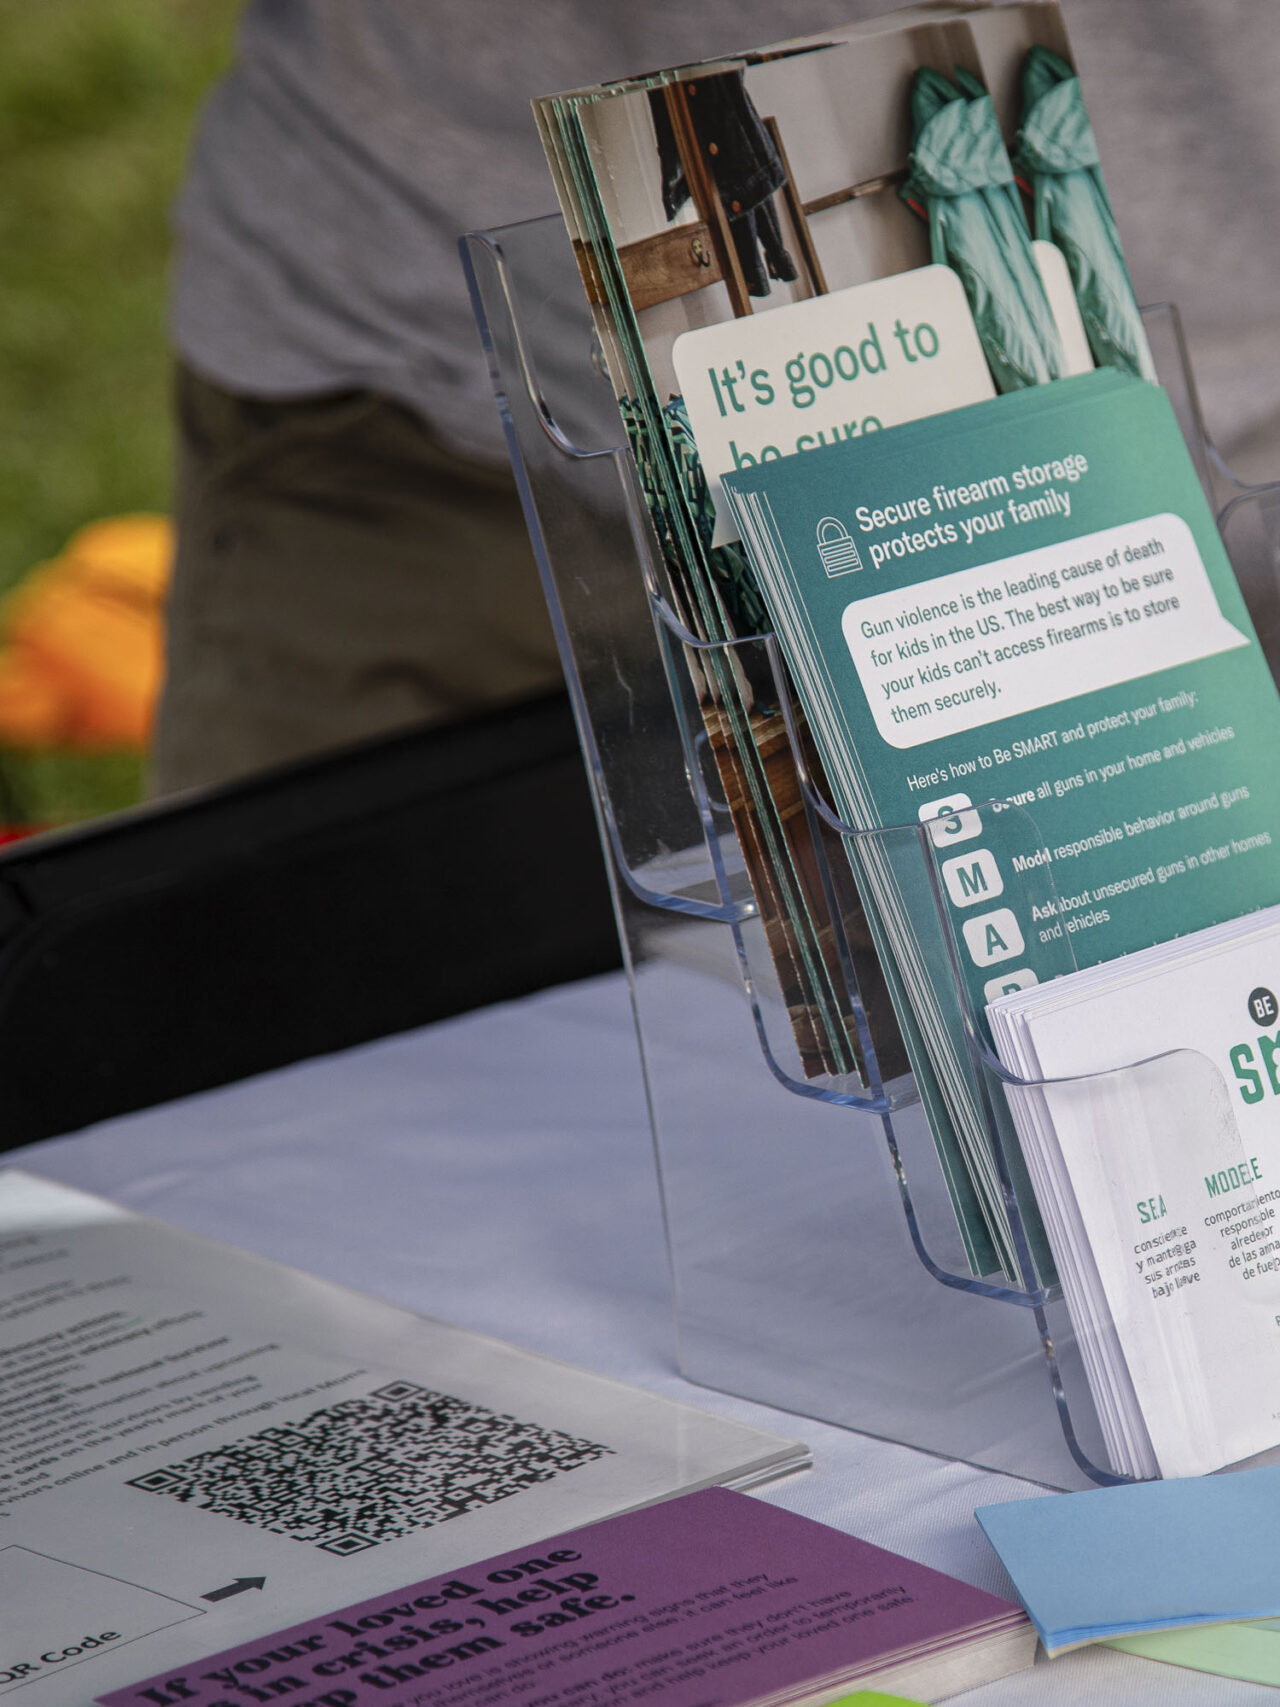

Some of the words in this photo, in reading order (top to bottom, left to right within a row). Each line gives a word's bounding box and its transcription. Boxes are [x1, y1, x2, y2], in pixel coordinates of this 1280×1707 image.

[707, 359, 775, 418] It’s
[784, 322, 888, 409] good
[893, 319, 940, 363] to
[855, 497, 932, 532] Secure
[932, 475, 1011, 511] firearm
[1011, 454, 1089, 490] storage
[868, 522, 959, 570] protects
[958, 509, 1006, 545] your
[1007, 487, 1072, 524] family
[860, 619, 895, 639] Gun
[895, 600, 960, 629] violence
[959, 593, 976, 611] is
[976, 586, 1003, 606] the
[1003, 569, 1061, 598] leading
[1060, 558, 1104, 582] cause
[1105, 548, 1121, 569] of
[1123, 538, 1166, 564] death
[870, 649, 893, 668] for
[895, 637, 930, 660] kids
[929, 632, 948, 650] in
[948, 625, 976, 645] the
[975, 614, 1006, 636] US.
[1003, 607, 1036, 627] The
[1035, 595, 1072, 619] best
[1071, 589, 1101, 608] way
[1101, 583, 1120, 599] to
[1119, 577, 1141, 594] be
[1141, 568, 1175, 588] sure
[880, 674, 915, 701] your
[916, 662, 952, 685] kids
[993, 636, 1046, 663] access
[1046, 617, 1109, 647] firearms
[1107, 610, 1124, 628] is
[1123, 607, 1142, 623] to
[1142, 596, 1181, 618] store
[890, 701, 933, 724] them
[934, 679, 1002, 711] securely.
[906, 767, 949, 792] Here's
[948, 760, 977, 779] how
[977, 755, 993, 769] to
[992, 748, 1012, 765] Be
[1011, 730, 1059, 759] SMART
[1060, 722, 1086, 744] and
[1086, 710, 1132, 739] protect
[1129, 703, 1158, 726] your
[1157, 690, 1199, 713] family:
[1036, 781, 1053, 799] all
[1053, 774, 1085, 798] guns
[1083, 768, 1099, 784] in
[1098, 756, 1133, 783] your
[1125, 749, 1162, 770] home
[1162, 739, 1187, 759] and
[1186, 726, 1236, 751] vehicles
[1053, 828, 1124, 860] responsible
[1123, 810, 1176, 837] behavior
[1177, 796, 1220, 820] around
[1220, 786, 1250, 809] guns
[956, 861, 989, 898] M
[1031, 900, 1059, 922] Ask
[1091, 869, 1156, 902] unsecured
[1155, 860, 1187, 884] guns
[1186, 855, 1200, 870] in
[1198, 844, 1231, 866] other
[1230, 831, 1272, 854] homes
[985, 923, 1009, 957] A
[1038, 920, 1064, 943] and
[1253, 995, 1275, 1019] BE
[13, 1456, 60, 1475] cards
[60, 1447, 85, 1458] on
[53, 1464, 106, 1486] online
[106, 1450, 140, 1466] and
[136, 1444, 158, 1453] in
[157, 1424, 215, 1448] person
[41, 1631, 122, 1663] Code
[135, 1676, 199, 1707] If
[201, 1632, 327, 1690] your
[327, 1578, 483, 1638] loved
[486, 1547, 584, 1586] one
[235, 1672, 310, 1704] in
[312, 1616, 486, 1678] crisis,
[479, 1569, 602, 1623] help
[358, 1634, 505, 1692] them
[510, 1594, 637, 1638] safe.
